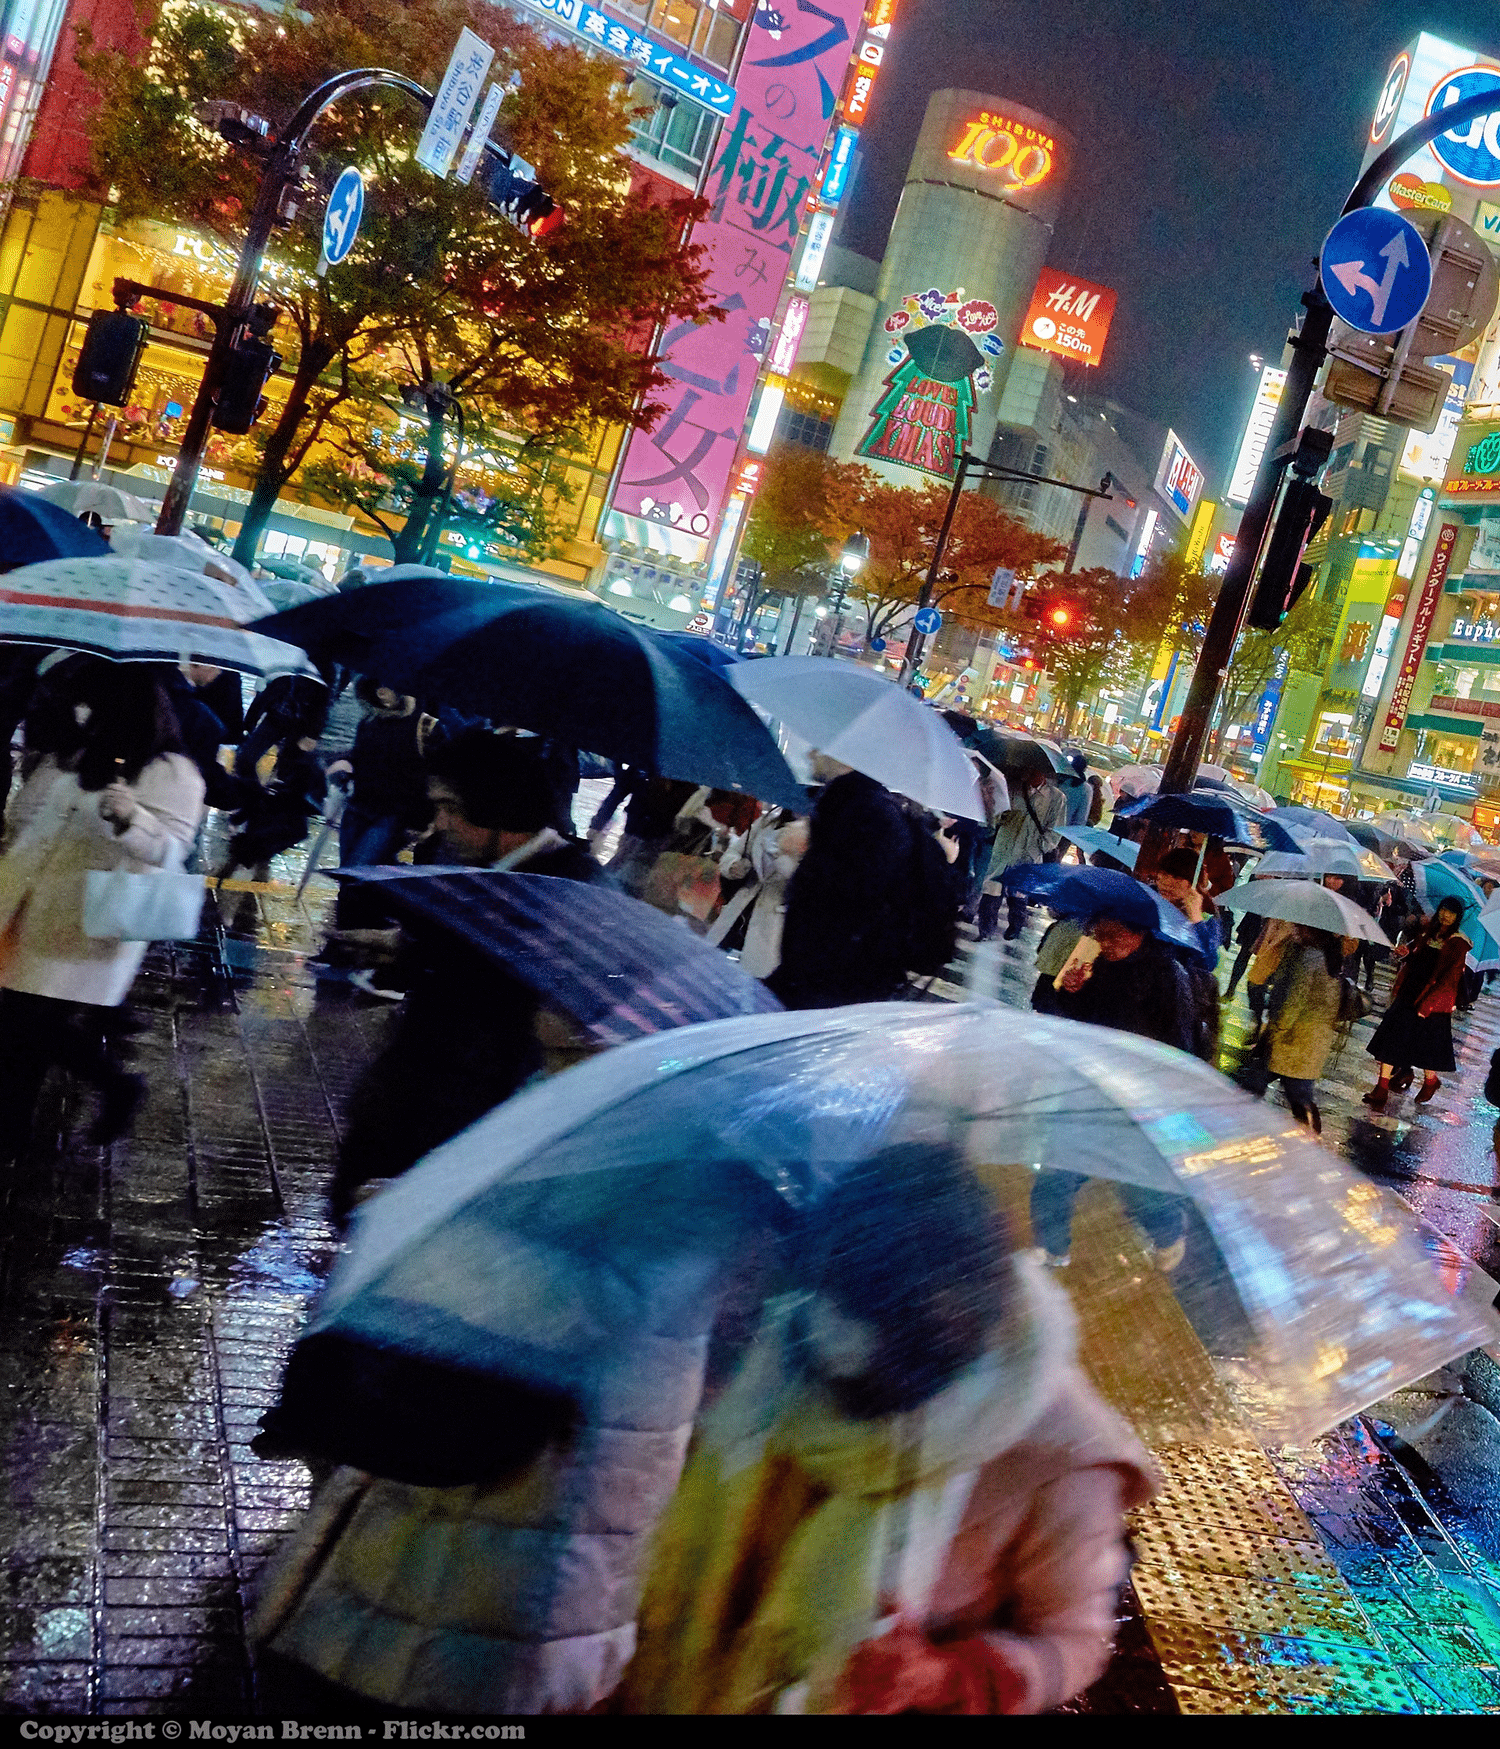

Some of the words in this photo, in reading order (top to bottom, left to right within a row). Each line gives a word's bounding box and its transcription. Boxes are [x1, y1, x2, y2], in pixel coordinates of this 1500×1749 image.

[584, 10, 730, 103] 英会話イーオン
[979, 112, 1054, 151] SHIBUYA
[947, 121, 1052, 191] 109
[1389, 181, 1451, 213] MasterCard
[1044, 282, 1101, 323] H&M
[1055, 331, 1092, 354] 150m
[1058, 322, 1086, 339] この先
[891, 394, 957, 435] LOUD!
[1407, 552, 1447, 664] ウィンターフルーツギフト
